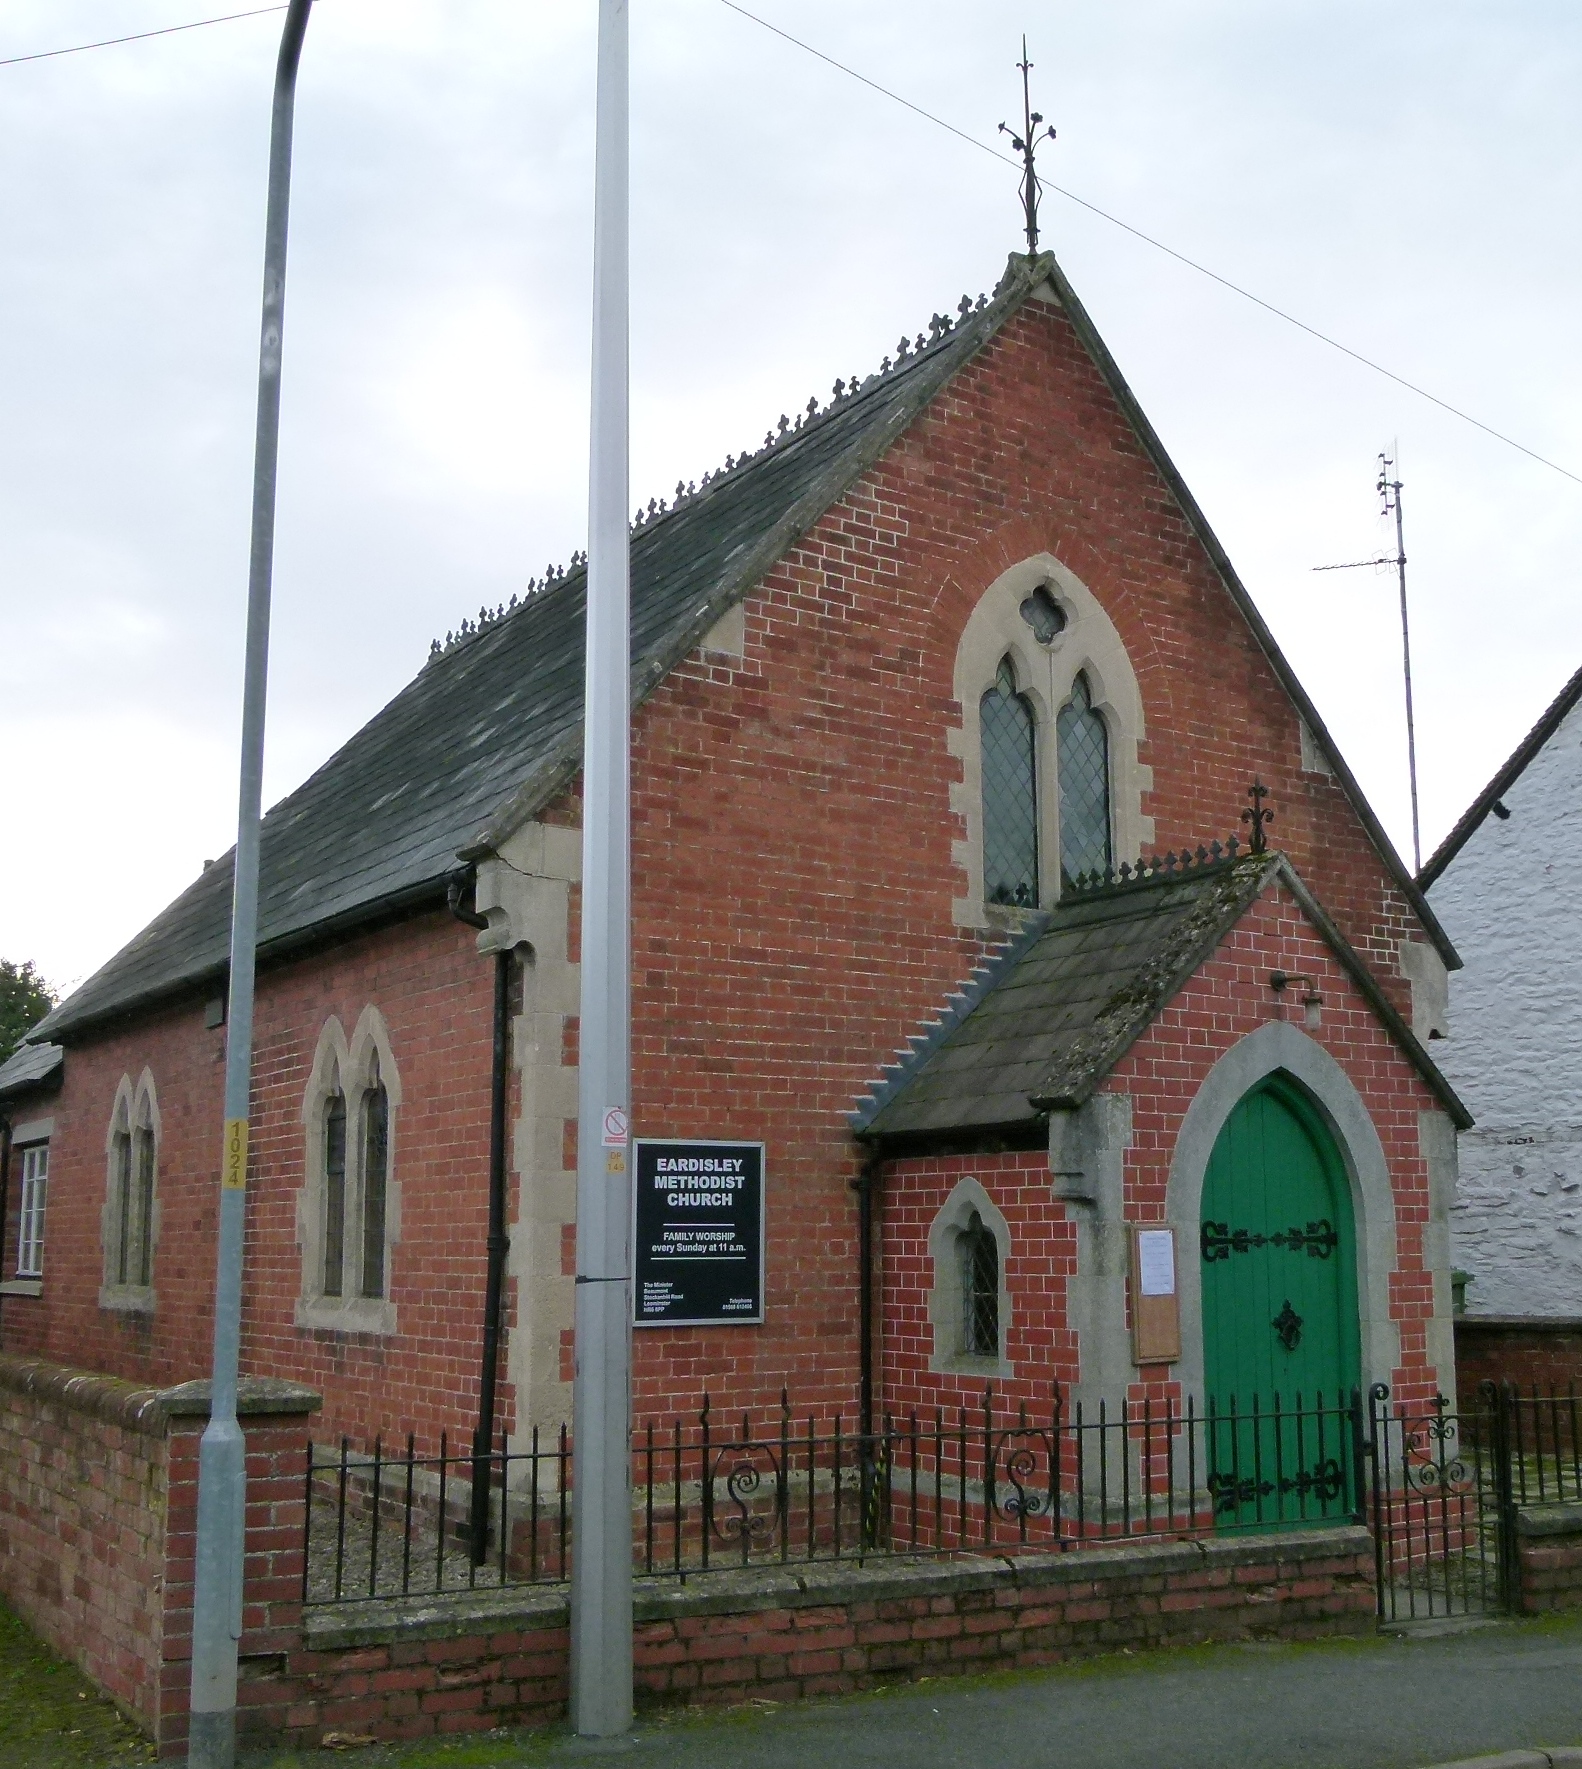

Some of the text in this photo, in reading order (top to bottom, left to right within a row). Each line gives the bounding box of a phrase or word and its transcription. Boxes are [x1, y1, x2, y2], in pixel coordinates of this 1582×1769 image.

[228, 1121, 241, 1186] 1024
[610, 1152, 622, 1160] DP
[656, 1158, 743, 1172] EARDISLEY
[654, 1175, 745, 1189] METHODIST
[667, 1193, 733, 1207] CHURCH
[663, 1232, 735, 1241] FAMILY WORSHIP
[651, 1243, 746, 1253] every Sunday at 11 a.m.
